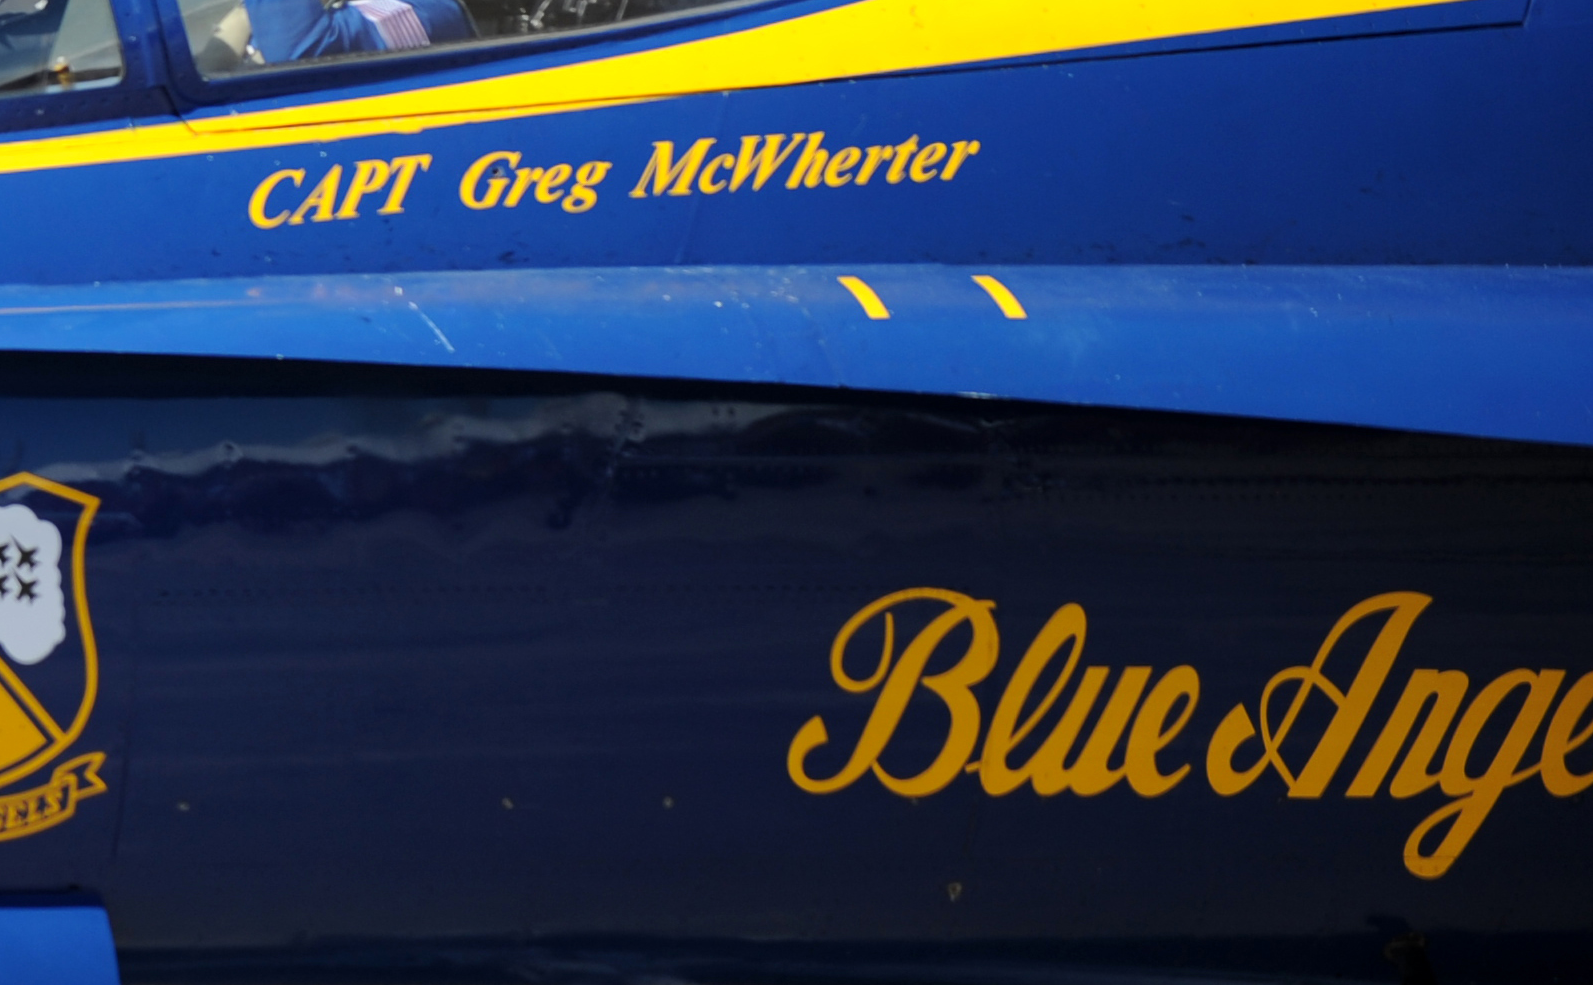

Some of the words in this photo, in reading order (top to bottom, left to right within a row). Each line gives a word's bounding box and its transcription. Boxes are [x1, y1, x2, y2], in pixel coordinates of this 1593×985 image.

[249, 154, 432, 229] CAPT
[459, 150, 612, 213] Greg
[630, 131, 981, 199] McWherter
[787, 587, 1202, 799] Blue
